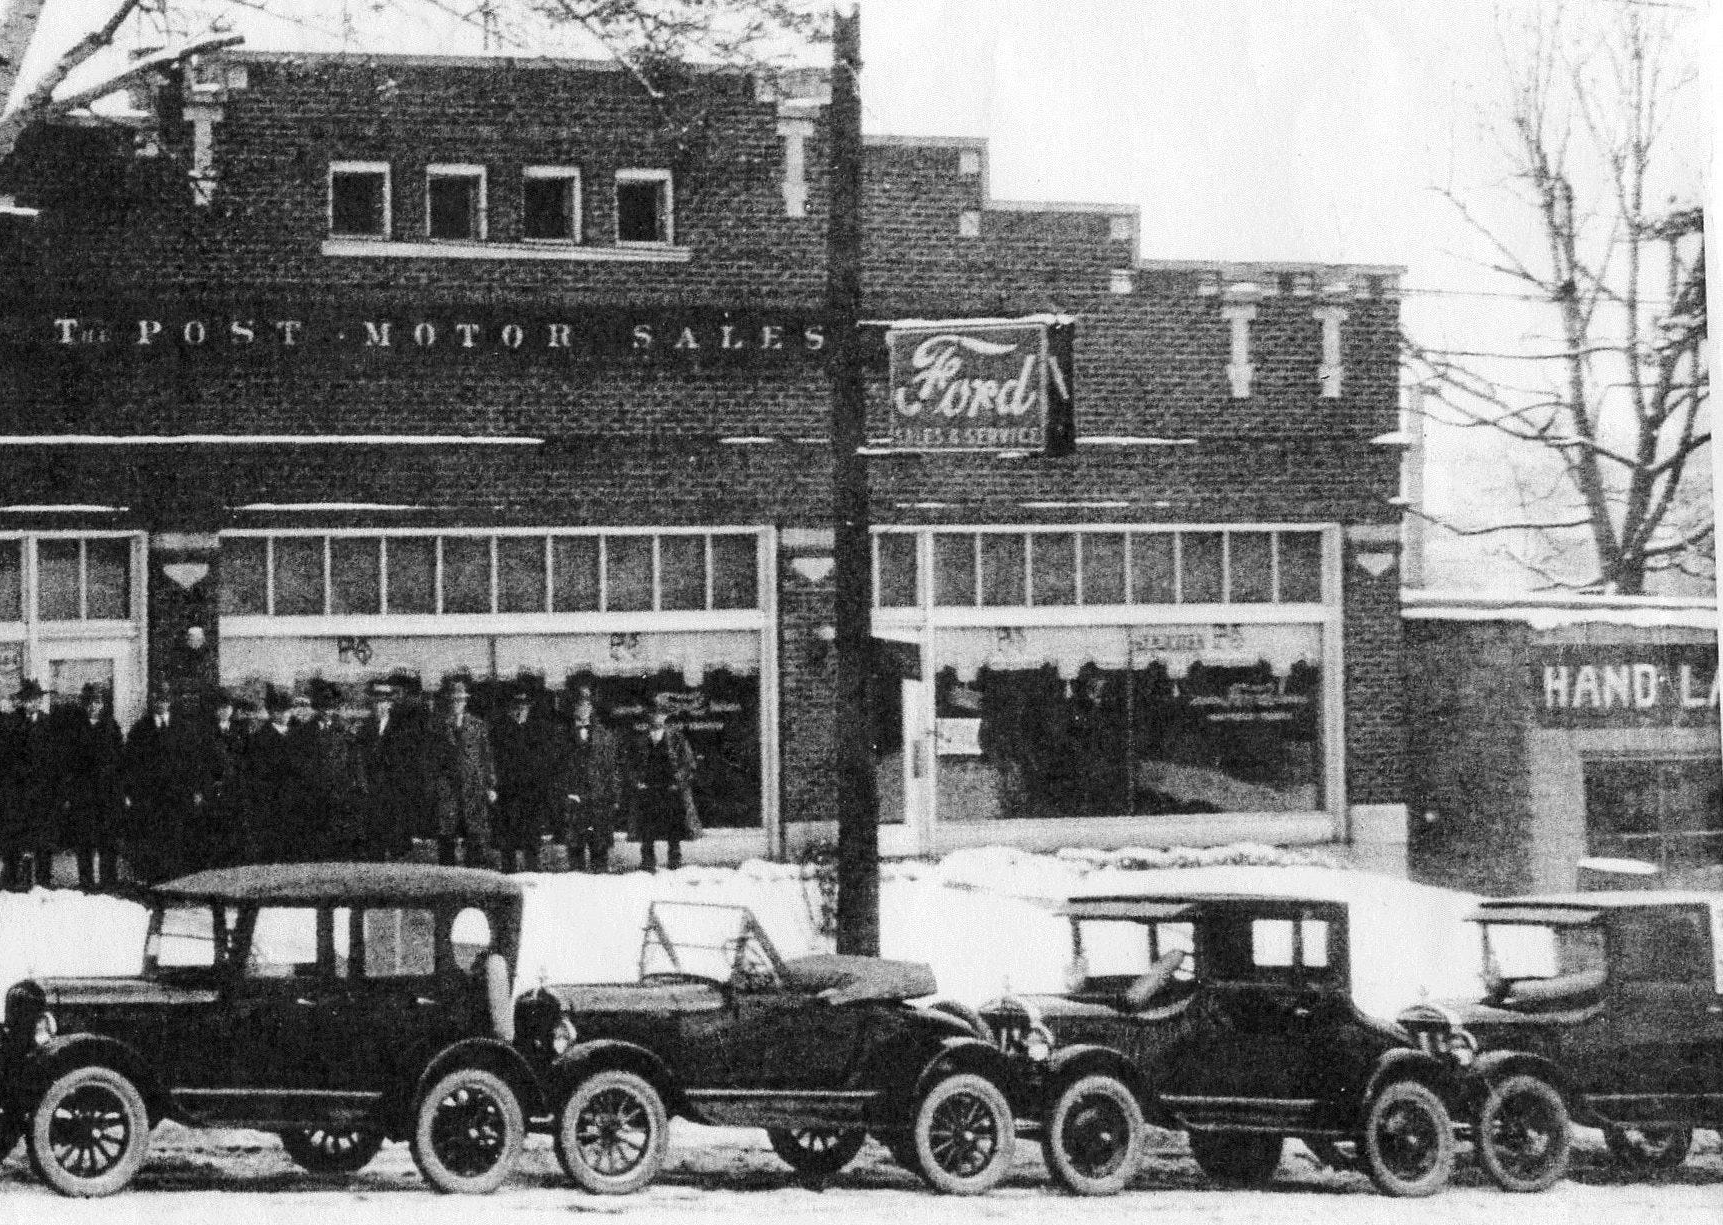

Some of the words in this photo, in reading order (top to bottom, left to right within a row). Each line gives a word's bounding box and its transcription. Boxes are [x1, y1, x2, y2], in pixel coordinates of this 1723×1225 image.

[137, 320, 303, 345] POST
[364, 321, 572, 348] MOTOR
[632, 324, 824, 350] SALES
[894, 334, 1038, 417] Ford
[964, 427, 1041, 445] SERVICE
[1542, 663, 1657, 709] HAND
